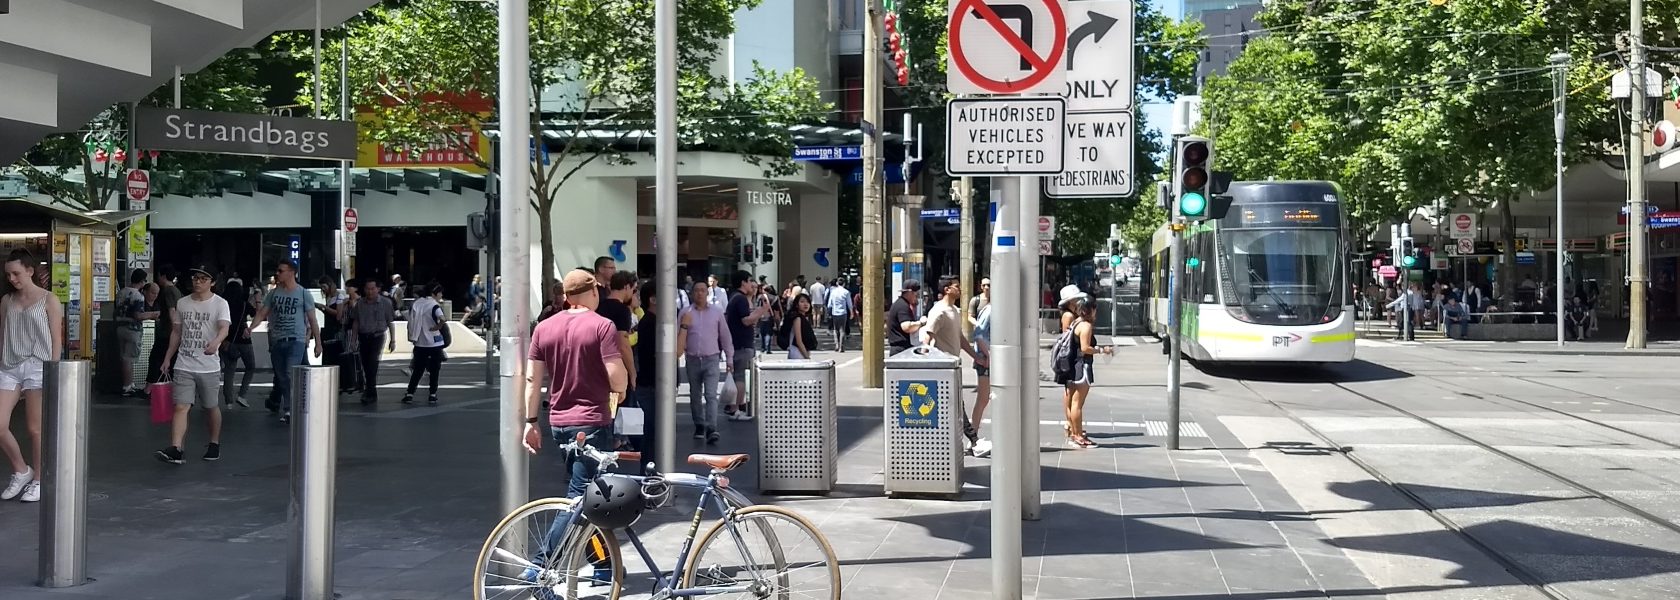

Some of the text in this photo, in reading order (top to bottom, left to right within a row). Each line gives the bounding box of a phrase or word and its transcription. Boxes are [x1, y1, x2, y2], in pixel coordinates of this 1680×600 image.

[958, 107, 1055, 122] AUTHORISED
[165, 114, 330, 153] Strandbags
[969, 128, 1044, 143] VEHICLES
[1067, 122, 1126, 138] VE WAY
[795, 148, 832, 156] Swanston
[833, 148, 842, 156] St
[967, 150, 1044, 164] EXCEPTED
[1079, 147, 1098, 162] TO
[1052, 170, 1125, 187] PEDESTRIANS
[746, 190, 793, 206] TELSTRA
[272, 295, 299, 306] SURF
[904, 417, 932, 426] Recycling
